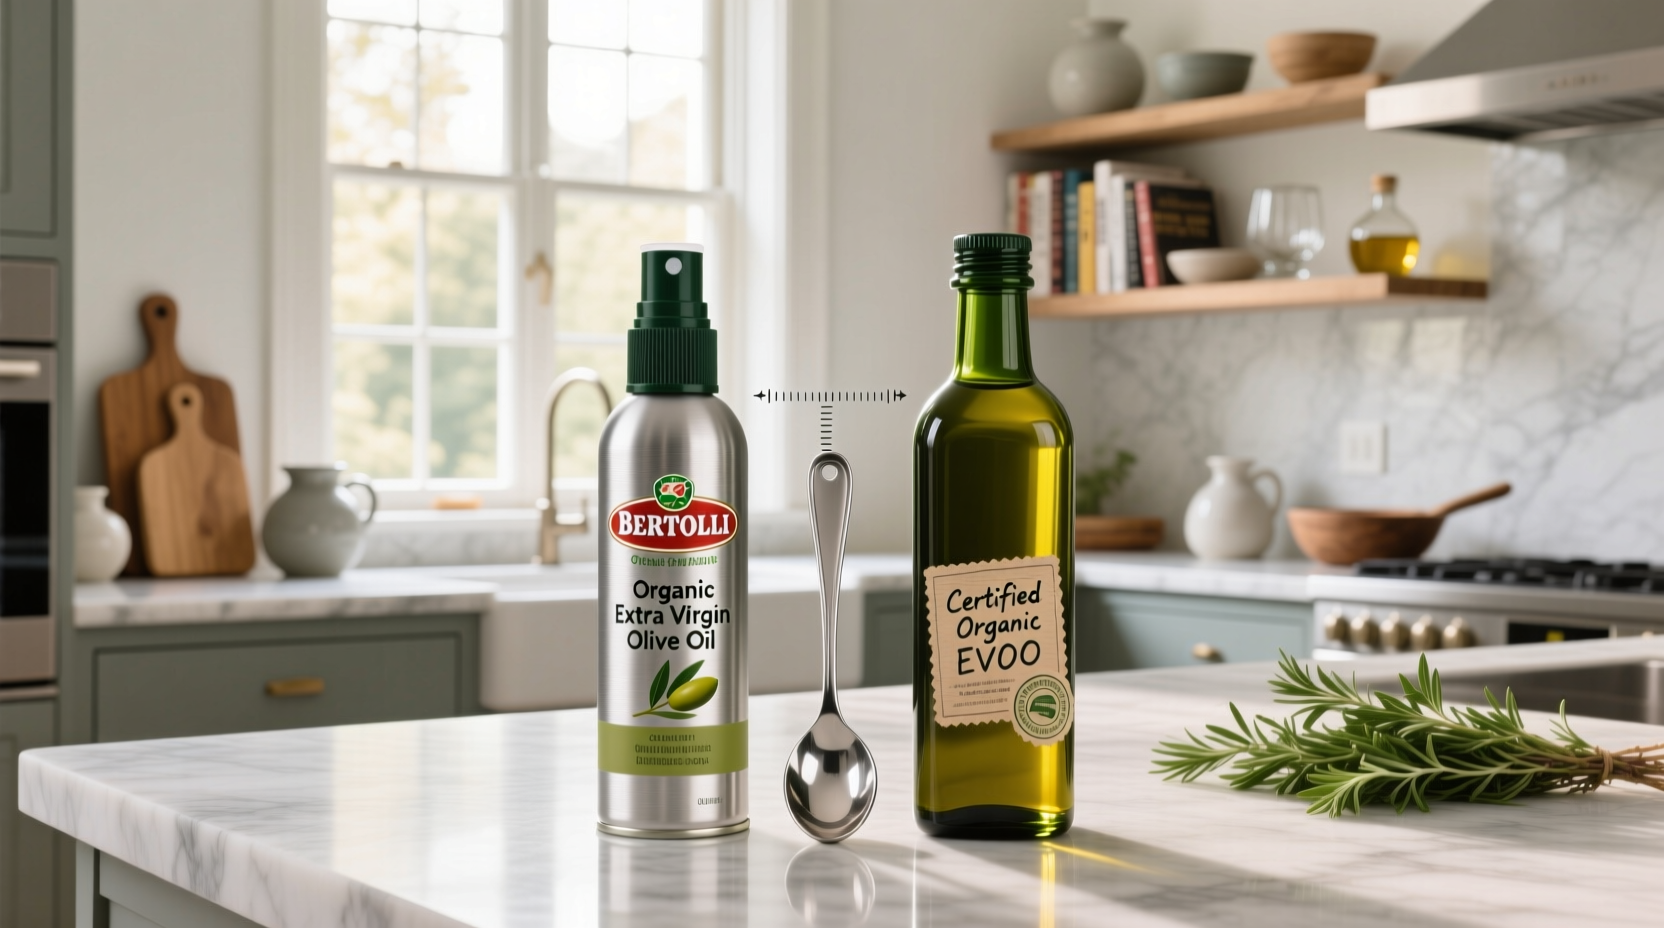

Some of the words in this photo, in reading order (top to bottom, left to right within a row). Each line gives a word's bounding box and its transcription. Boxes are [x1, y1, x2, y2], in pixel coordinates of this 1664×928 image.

[618, 510, 730, 537] BERTOLLI
[633, 579, 715, 605] Organic
[947, 580, 1042, 613] Certified
[615, 604, 664, 625] Extra
[670, 604, 730, 629] Virgin
[957, 611, 1041, 644] Organic
[627, 629, 680, 650] Olive
[686, 629, 715, 650] Oil
[957, 639, 1041, 676] EVOO
